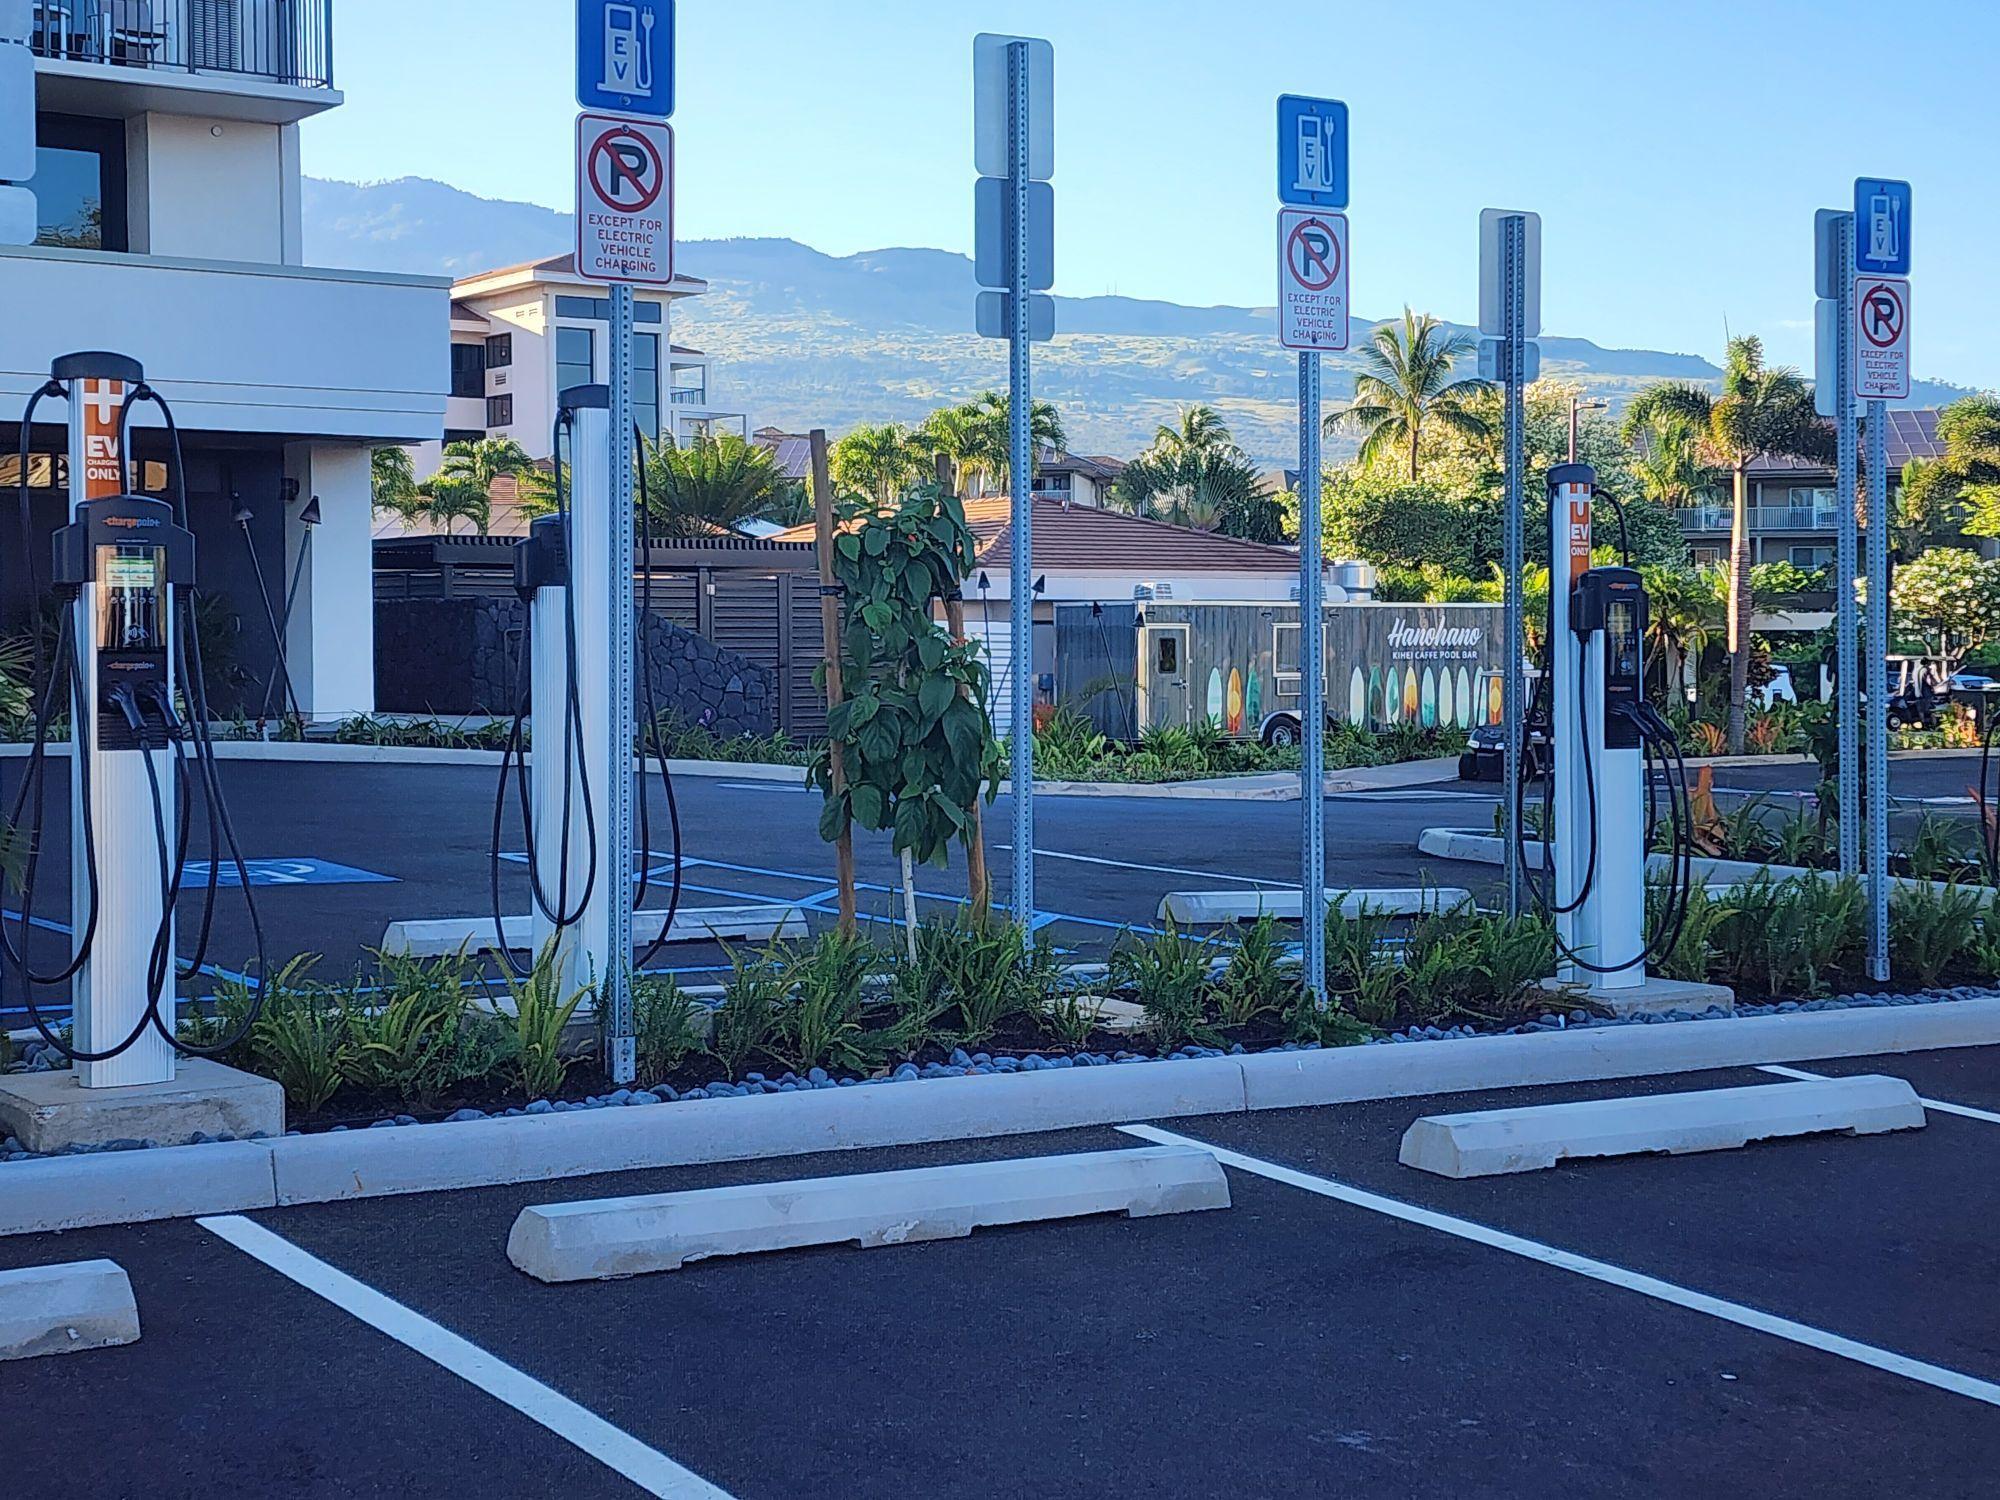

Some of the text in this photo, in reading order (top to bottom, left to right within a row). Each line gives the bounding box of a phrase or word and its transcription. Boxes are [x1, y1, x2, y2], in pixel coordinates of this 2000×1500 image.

[588, 213, 662, 232] EXCEPT FOR
[597, 229, 654, 245] ELECTRIC
[601, 243, 652, 259] VEHICLE
[595, 257, 656, 273] CHARGING
[1288, 293, 1341, 306] EXCEPT FOR
[1294, 305, 1335, 317] ELECTRIC
[1296, 317, 1334, 329] VEHICLE
[1292, 328, 1337, 341] CHARGING
[1861, 350, 1904, 360] EXCEPT FOR
[1865, 360, 1899, 371] ELECTRIC
[1867, 371, 1898, 381] VEHICLE
[87, 435, 118, 459] EV
[87, 467, 120, 481] ONLY
[1571, 524, 1589, 540] EV
[1571, 546, 1589, 556] ONLY
[1387, 614, 1483, 649] Hanohano
[1392, 651, 1478, 660] KIHEI CAFFE POOL BAR
